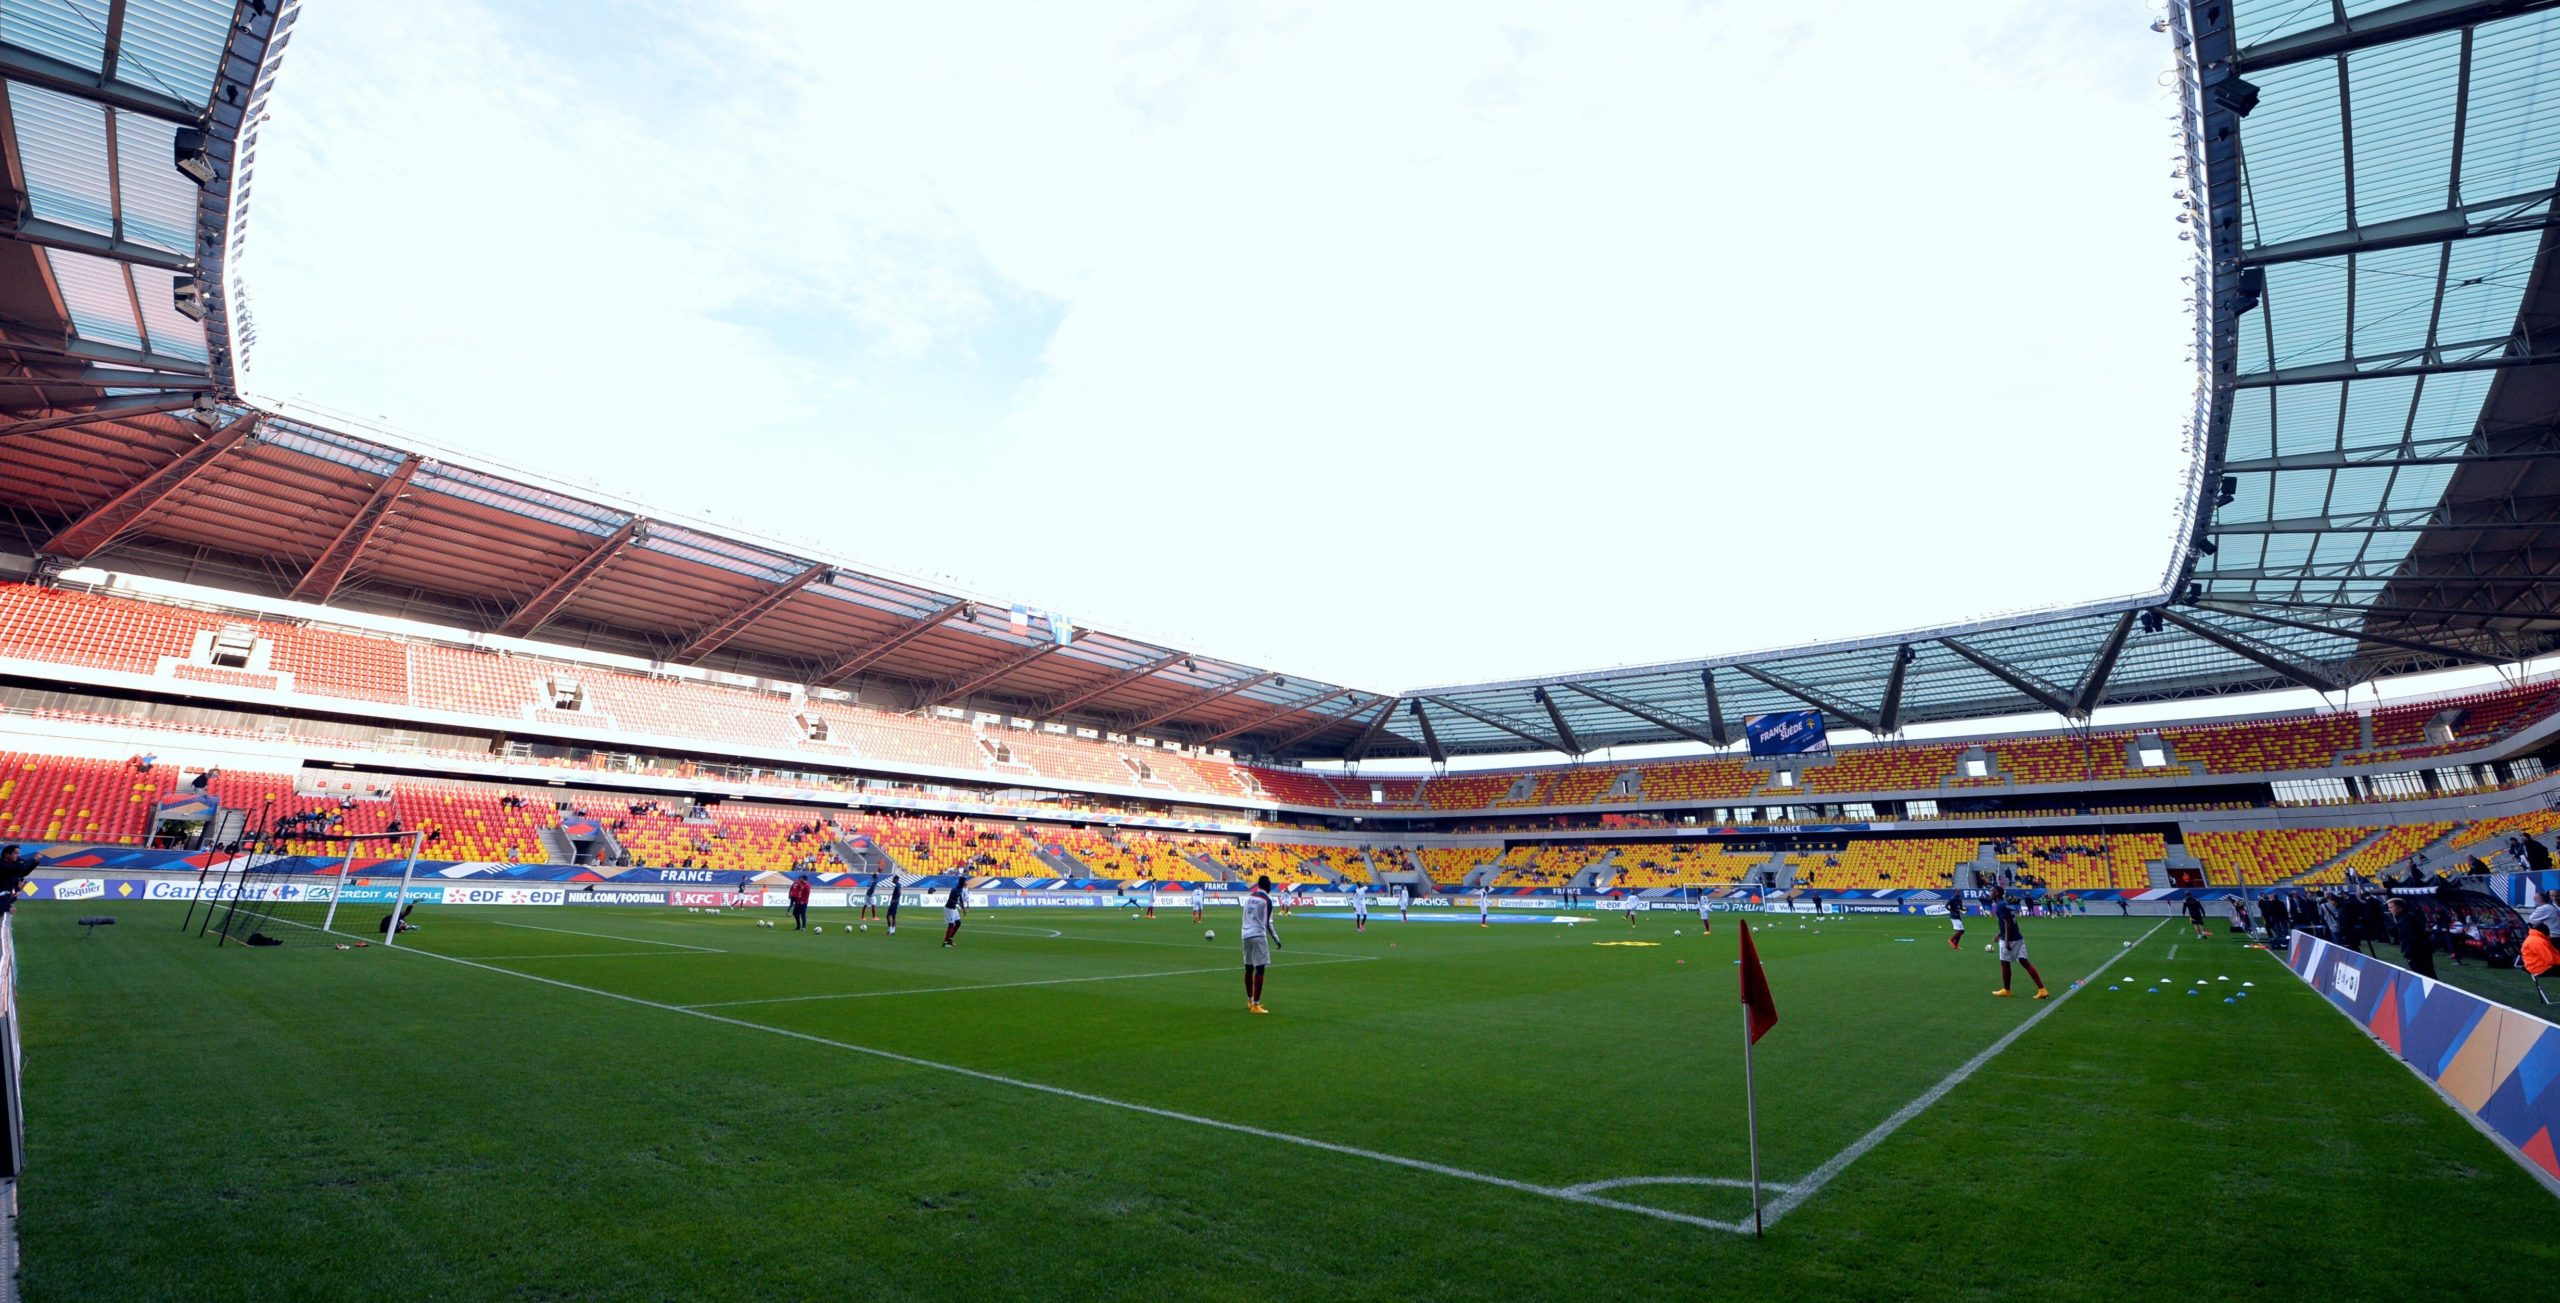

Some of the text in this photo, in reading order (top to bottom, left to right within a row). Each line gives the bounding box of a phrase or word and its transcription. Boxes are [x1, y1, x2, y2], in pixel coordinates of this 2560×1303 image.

[1760, 722, 1787, 743] FRANCE
[1780, 721, 1803, 740] SUÈDE
[660, 870, 713, 881] FRANCE
[58, 885, 101, 898] Pasquier
[152, 882, 267, 899] Carrefour
[1204, 882, 1228, 890] FRANCE
[568, 892, 665, 903] NIKE.COM/FOOTBALL
[684, 894, 715, 904] KFC
[1027, 897, 1036, 905] DE
[1038, 897, 1065, 905] FRANCE
